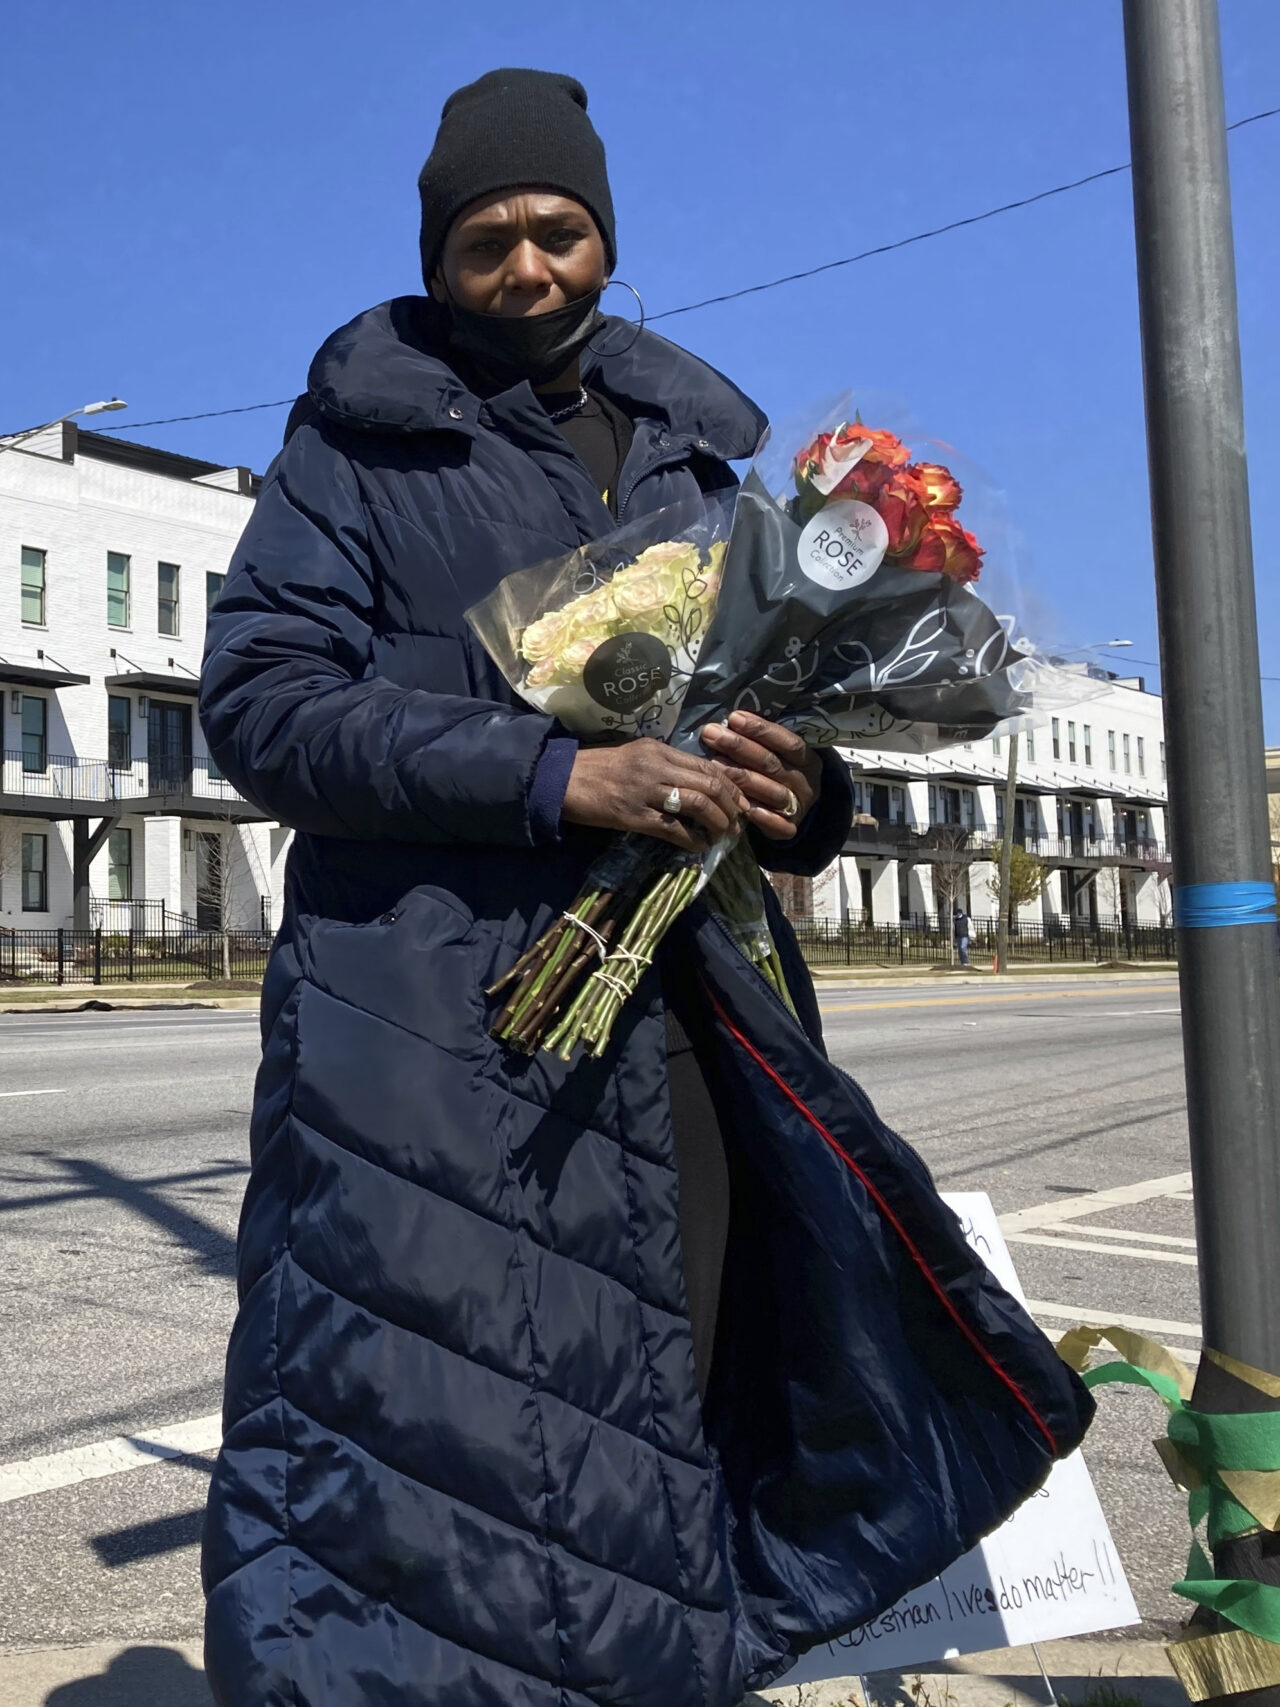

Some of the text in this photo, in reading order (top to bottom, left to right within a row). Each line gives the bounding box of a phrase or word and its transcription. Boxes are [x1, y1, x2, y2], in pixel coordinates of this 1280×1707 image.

[813, 530, 863, 577] ROSE
[833, 526, 865, 556] Premium
[602, 666, 661, 698] ROSE
[614, 663, 648, 678] Classic
[938, 1575, 998, 1621] lives
[999, 1576, 1023, 1611] do
